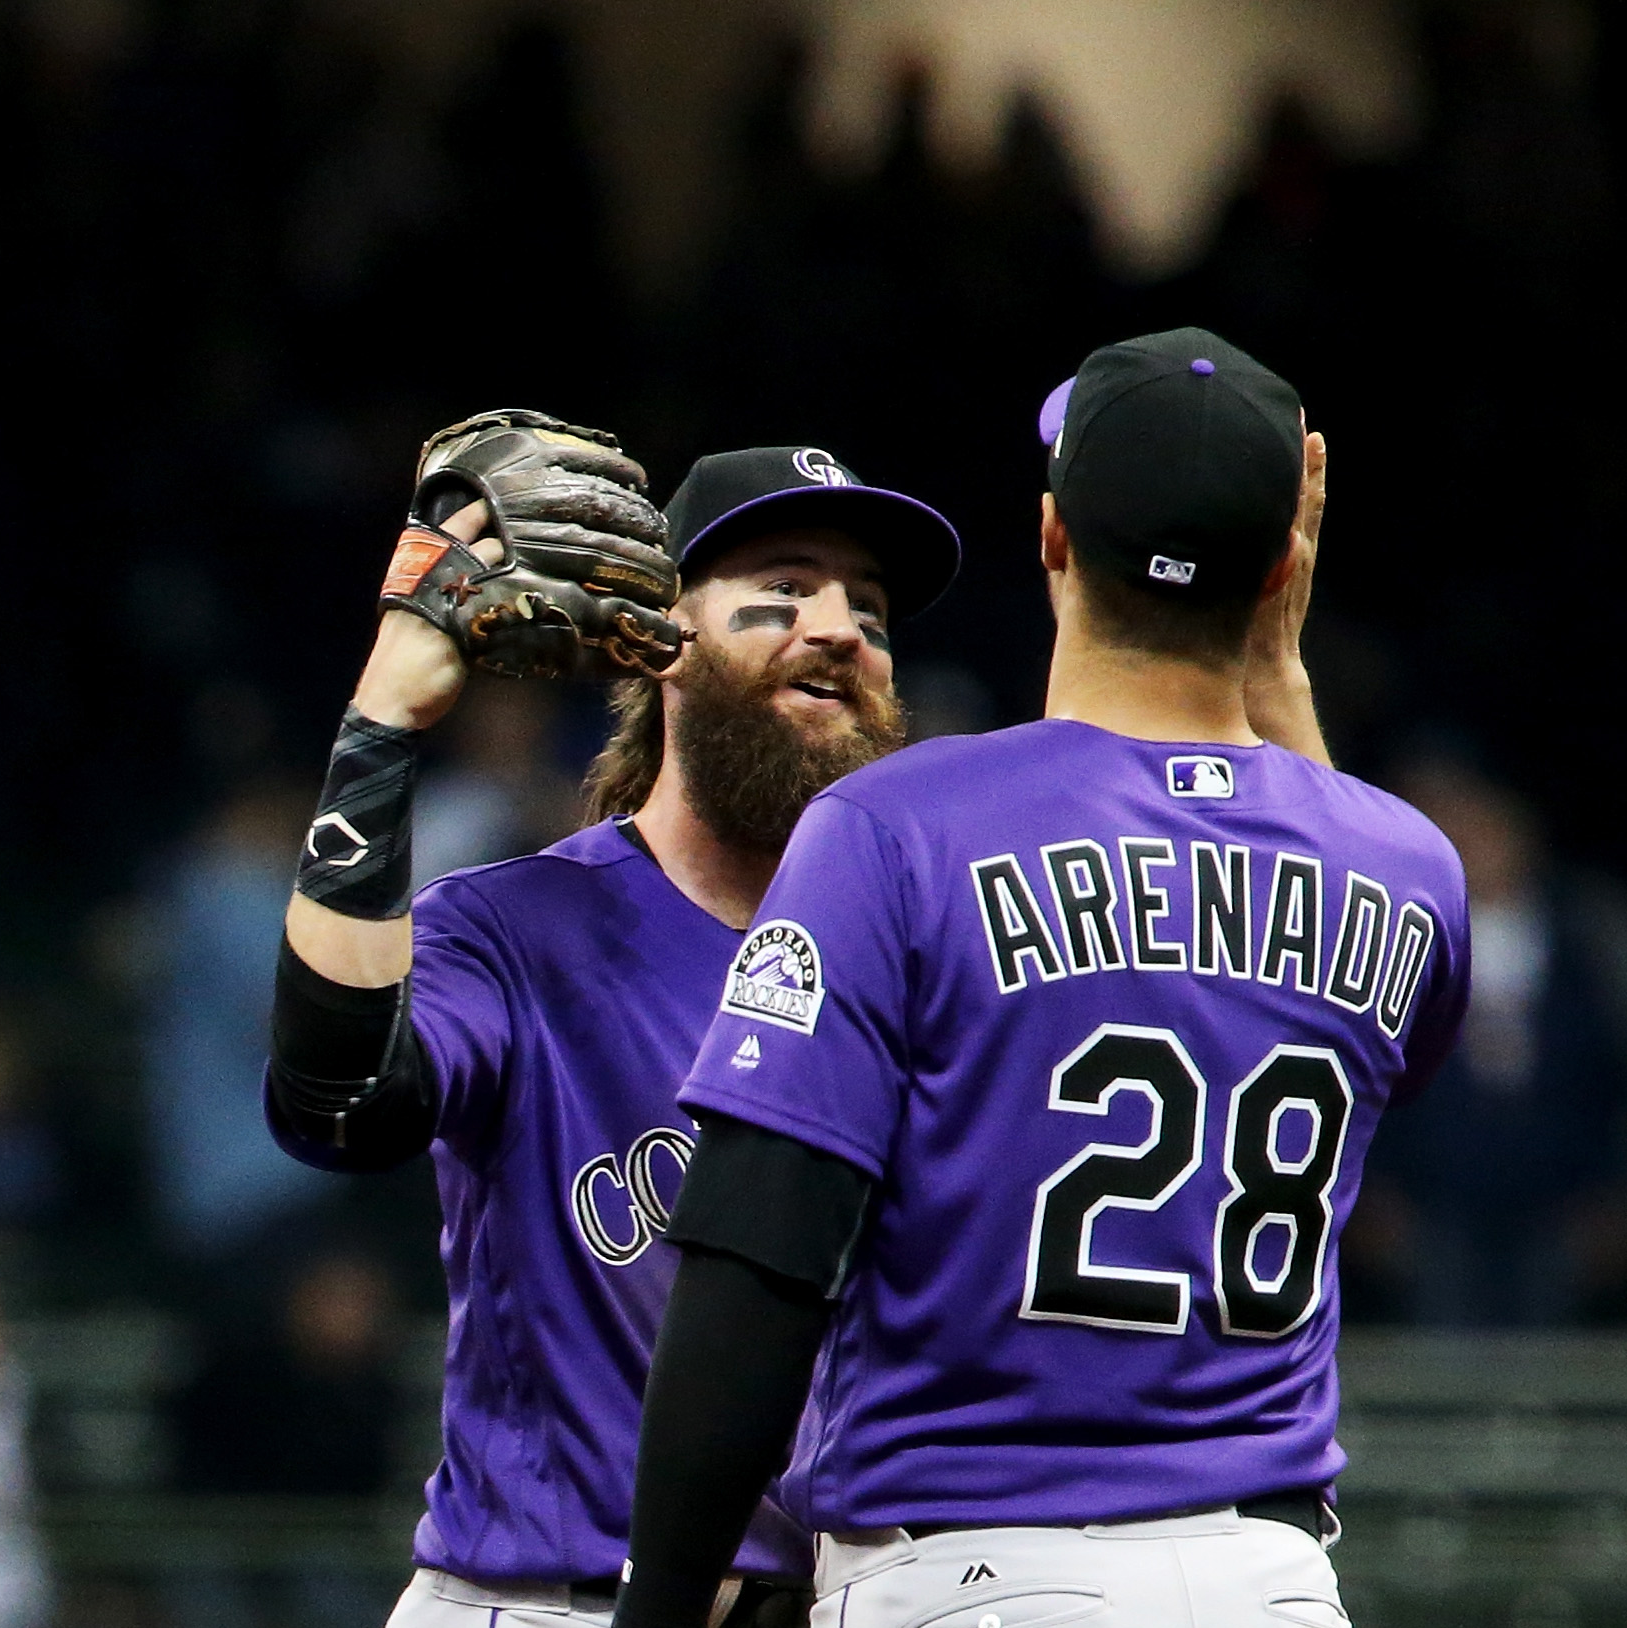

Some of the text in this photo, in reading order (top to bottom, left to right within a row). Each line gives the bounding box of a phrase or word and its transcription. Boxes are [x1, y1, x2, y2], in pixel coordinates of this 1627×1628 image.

[730, 975, 813, 1018] ROCKIES
[741, 928, 815, 982] COLORADO
[970, 837, 1434, 1039] ARENADO
[571, 1120, 701, 1266] CO
[1018, 1022, 1354, 1339] 28
